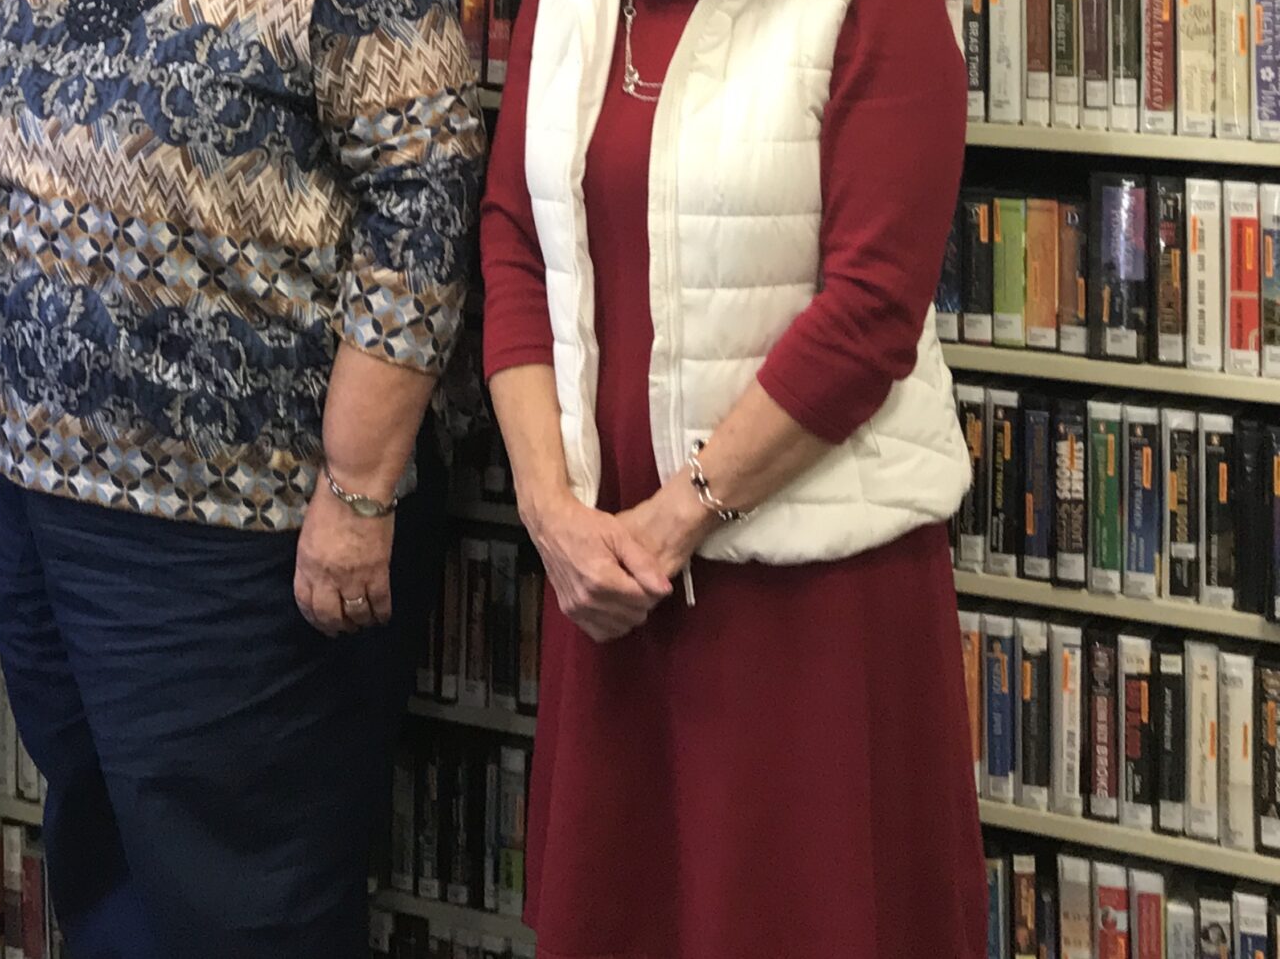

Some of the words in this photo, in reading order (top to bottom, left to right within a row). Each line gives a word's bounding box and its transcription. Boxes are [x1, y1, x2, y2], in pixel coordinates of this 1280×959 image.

[969, 21, 979, 52] BRAD
[1056, 4, 1066, 53] HOBBIT
[969, 55, 979, 87] THOR
[1056, 441, 1070, 501] WOODS
